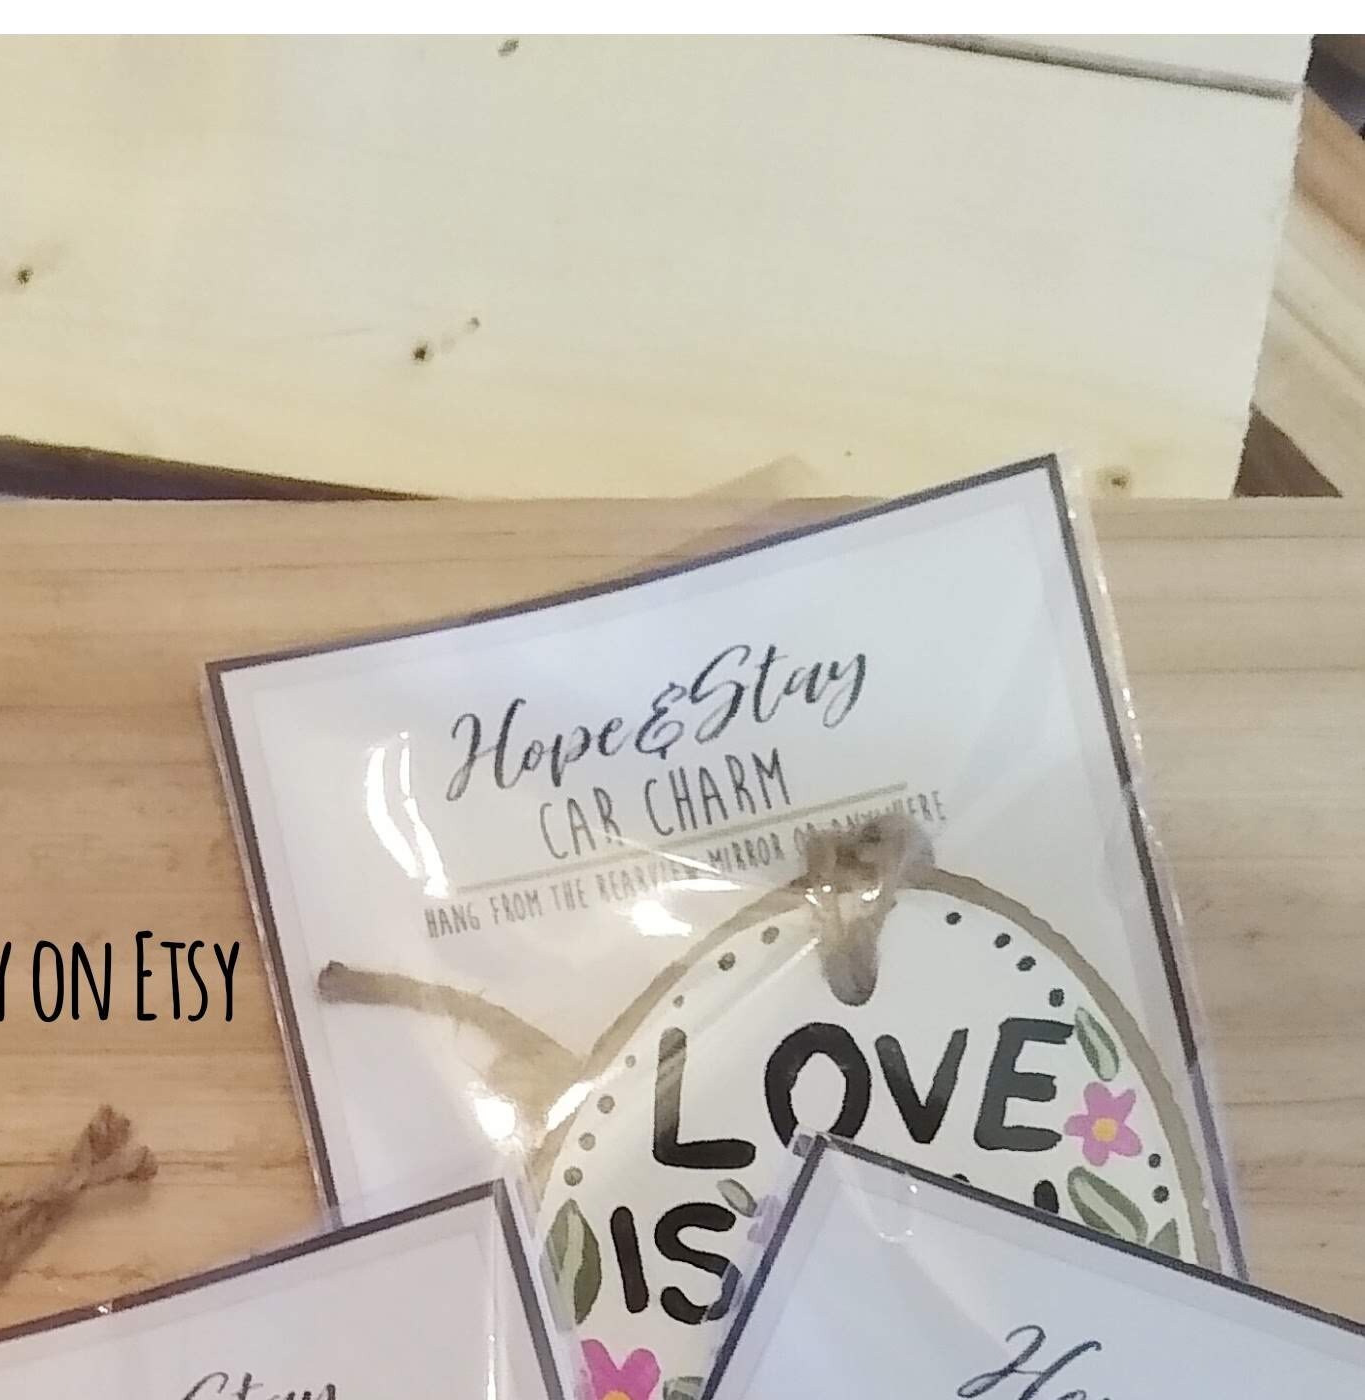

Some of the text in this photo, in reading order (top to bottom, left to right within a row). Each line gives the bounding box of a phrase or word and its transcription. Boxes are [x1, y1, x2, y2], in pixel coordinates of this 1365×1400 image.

[540, 787, 622, 860] CAR
[643, 747, 792, 837] CHARM
[423, 902, 482, 938] HANG
[489, 890, 541, 924] FROM
[549, 878, 588, 912] THE
[707, 832, 785, 873] MIRROR
[653, 1017, 1074, 1169] LOVE
[610, 1203, 743, 1325] IS
